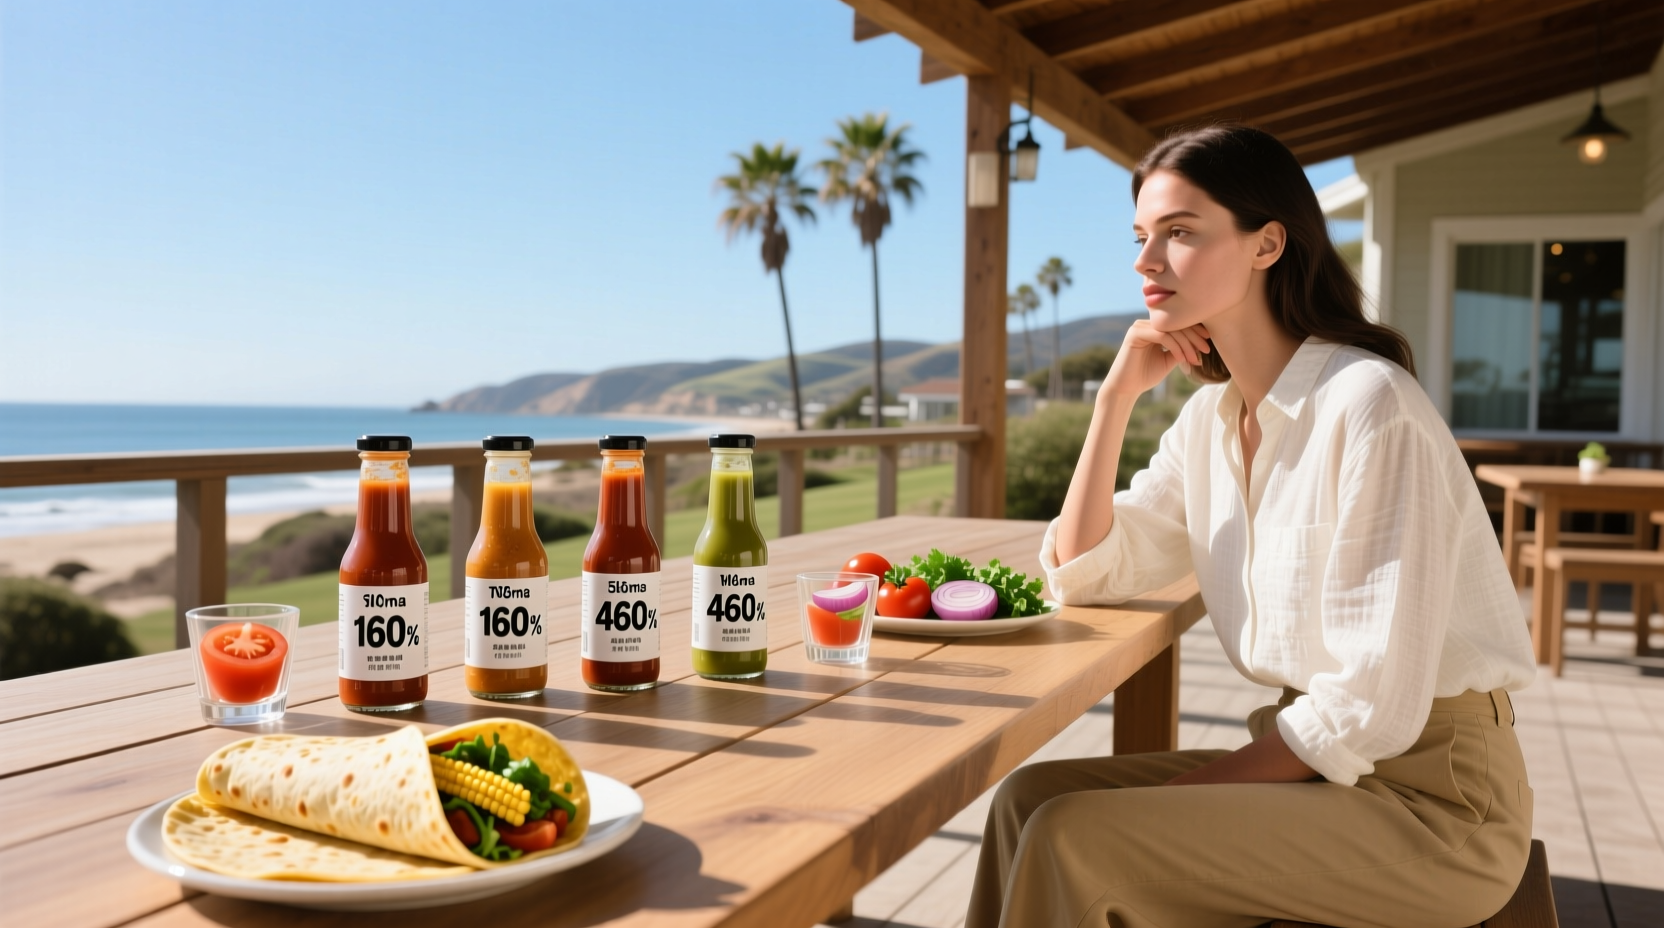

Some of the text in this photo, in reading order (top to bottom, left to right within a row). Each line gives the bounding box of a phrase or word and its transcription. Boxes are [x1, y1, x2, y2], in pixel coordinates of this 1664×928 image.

[479, 606, 542, 637] 160%
[595, 600, 657, 631] 460%
[706, 593, 765, 622] 460%
[354, 615, 419, 648] 160%
